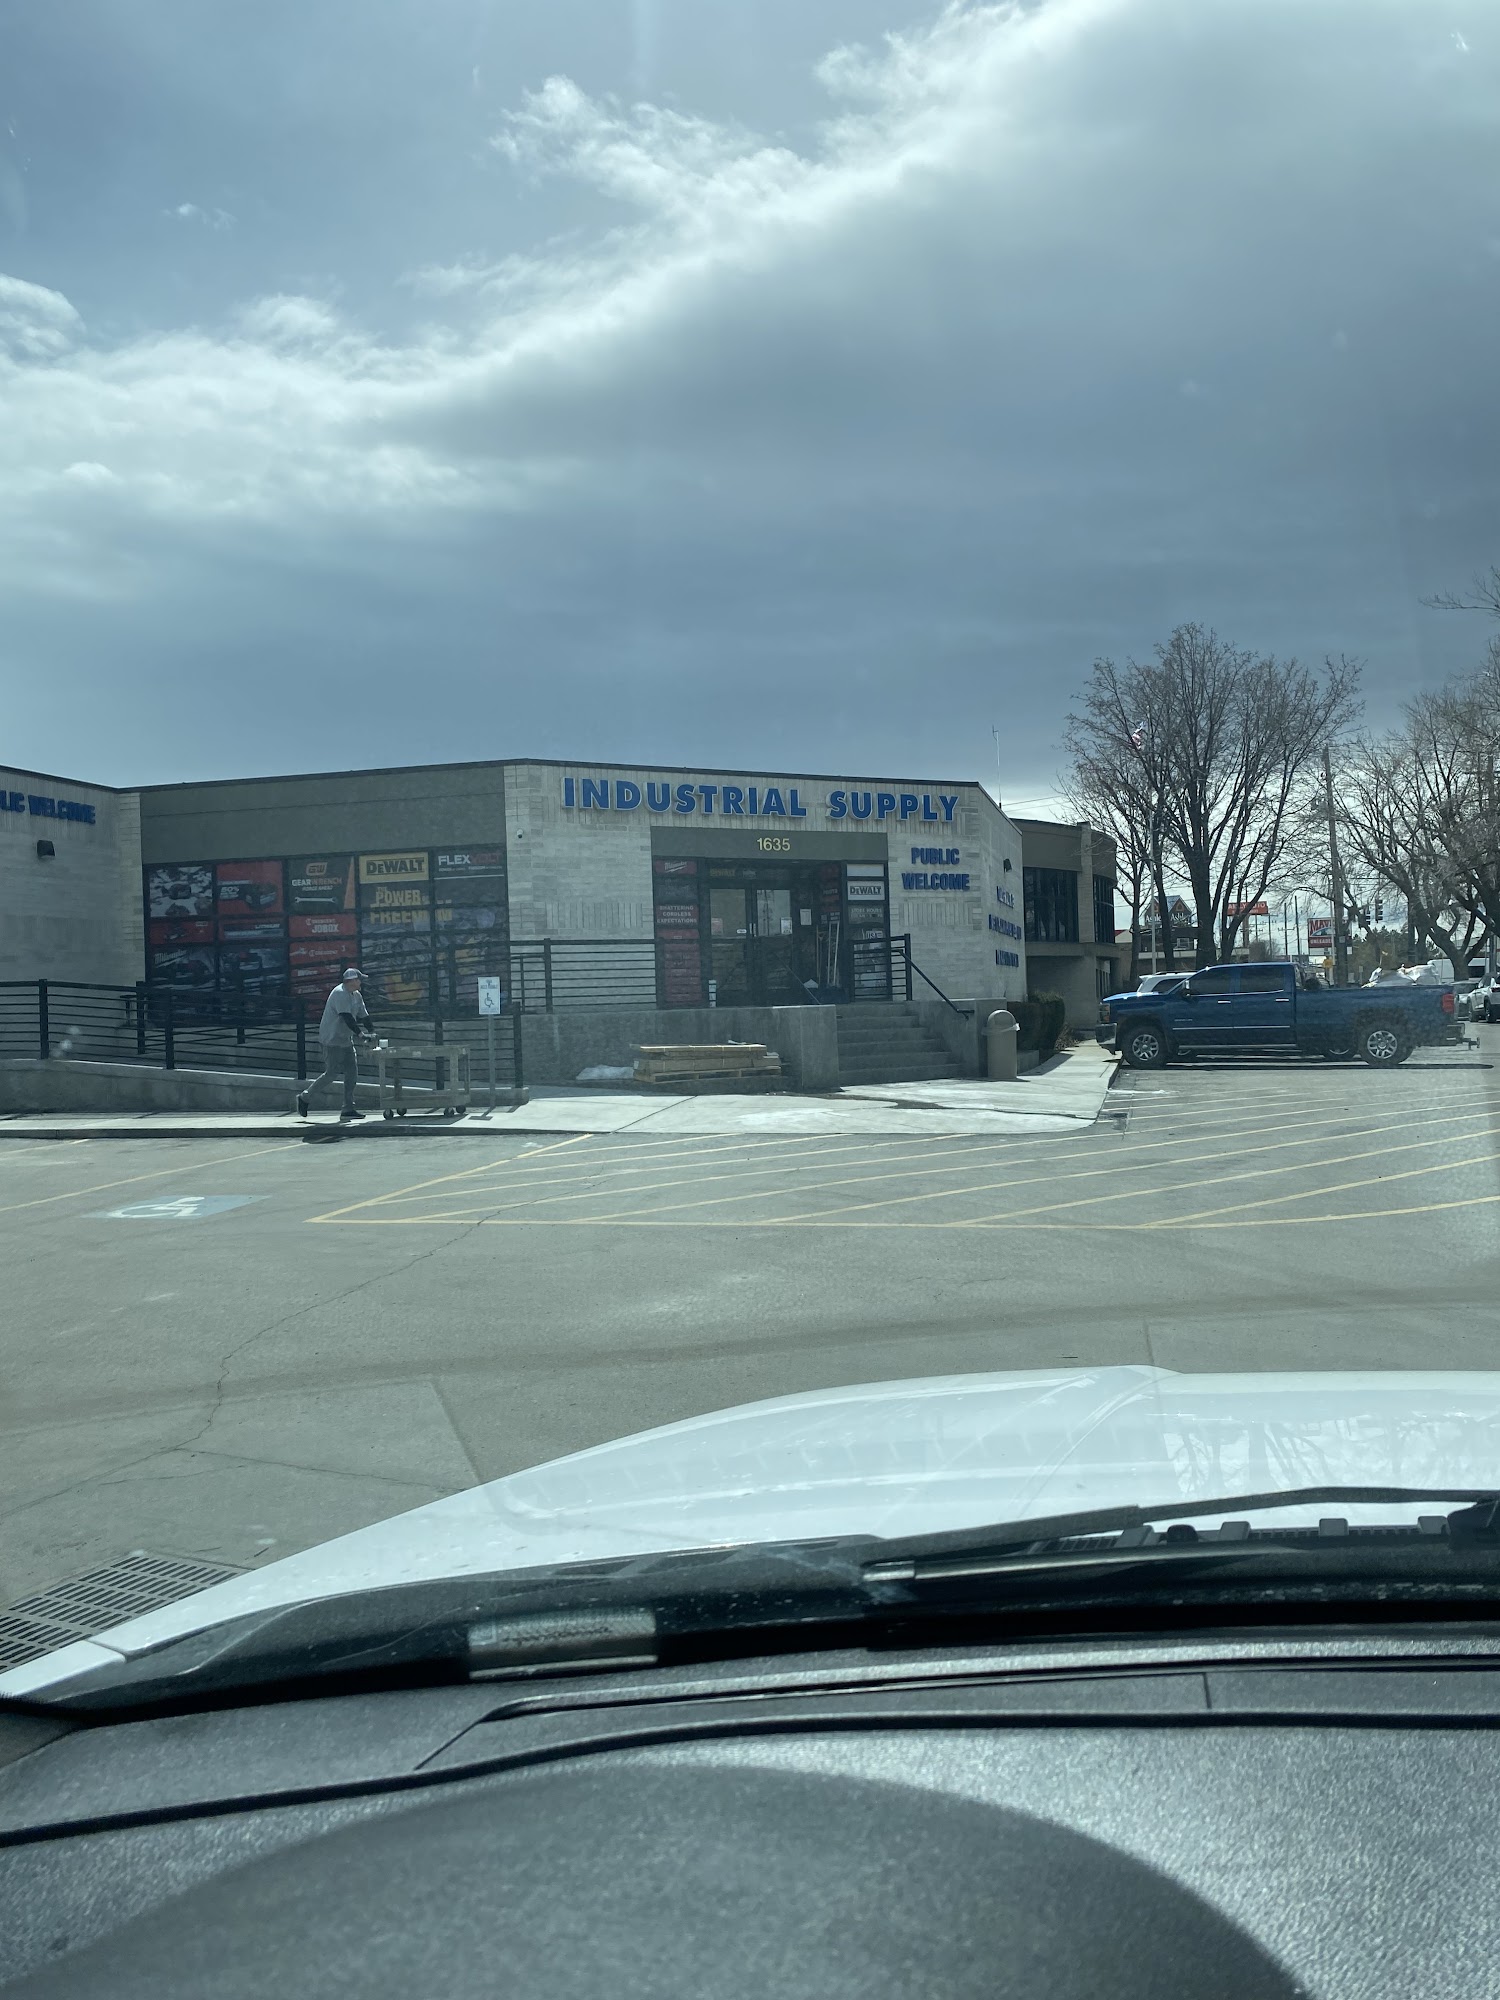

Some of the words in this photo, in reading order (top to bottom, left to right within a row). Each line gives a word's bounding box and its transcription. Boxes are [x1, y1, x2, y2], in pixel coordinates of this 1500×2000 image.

[562, 776, 807, 817] INDUSTRIAL
[826, 789, 960, 822] SUPPLY
[28, 794, 96, 824] WELCOME
[757, 837, 791, 851] 1635
[911, 847, 960, 865] PUBLIC
[366, 858, 424, 876] DEWALT
[850, 886, 881, 895] DEWALT
[901, 873, 970, 891] WELCOME
[376, 889, 420, 905] POWER
